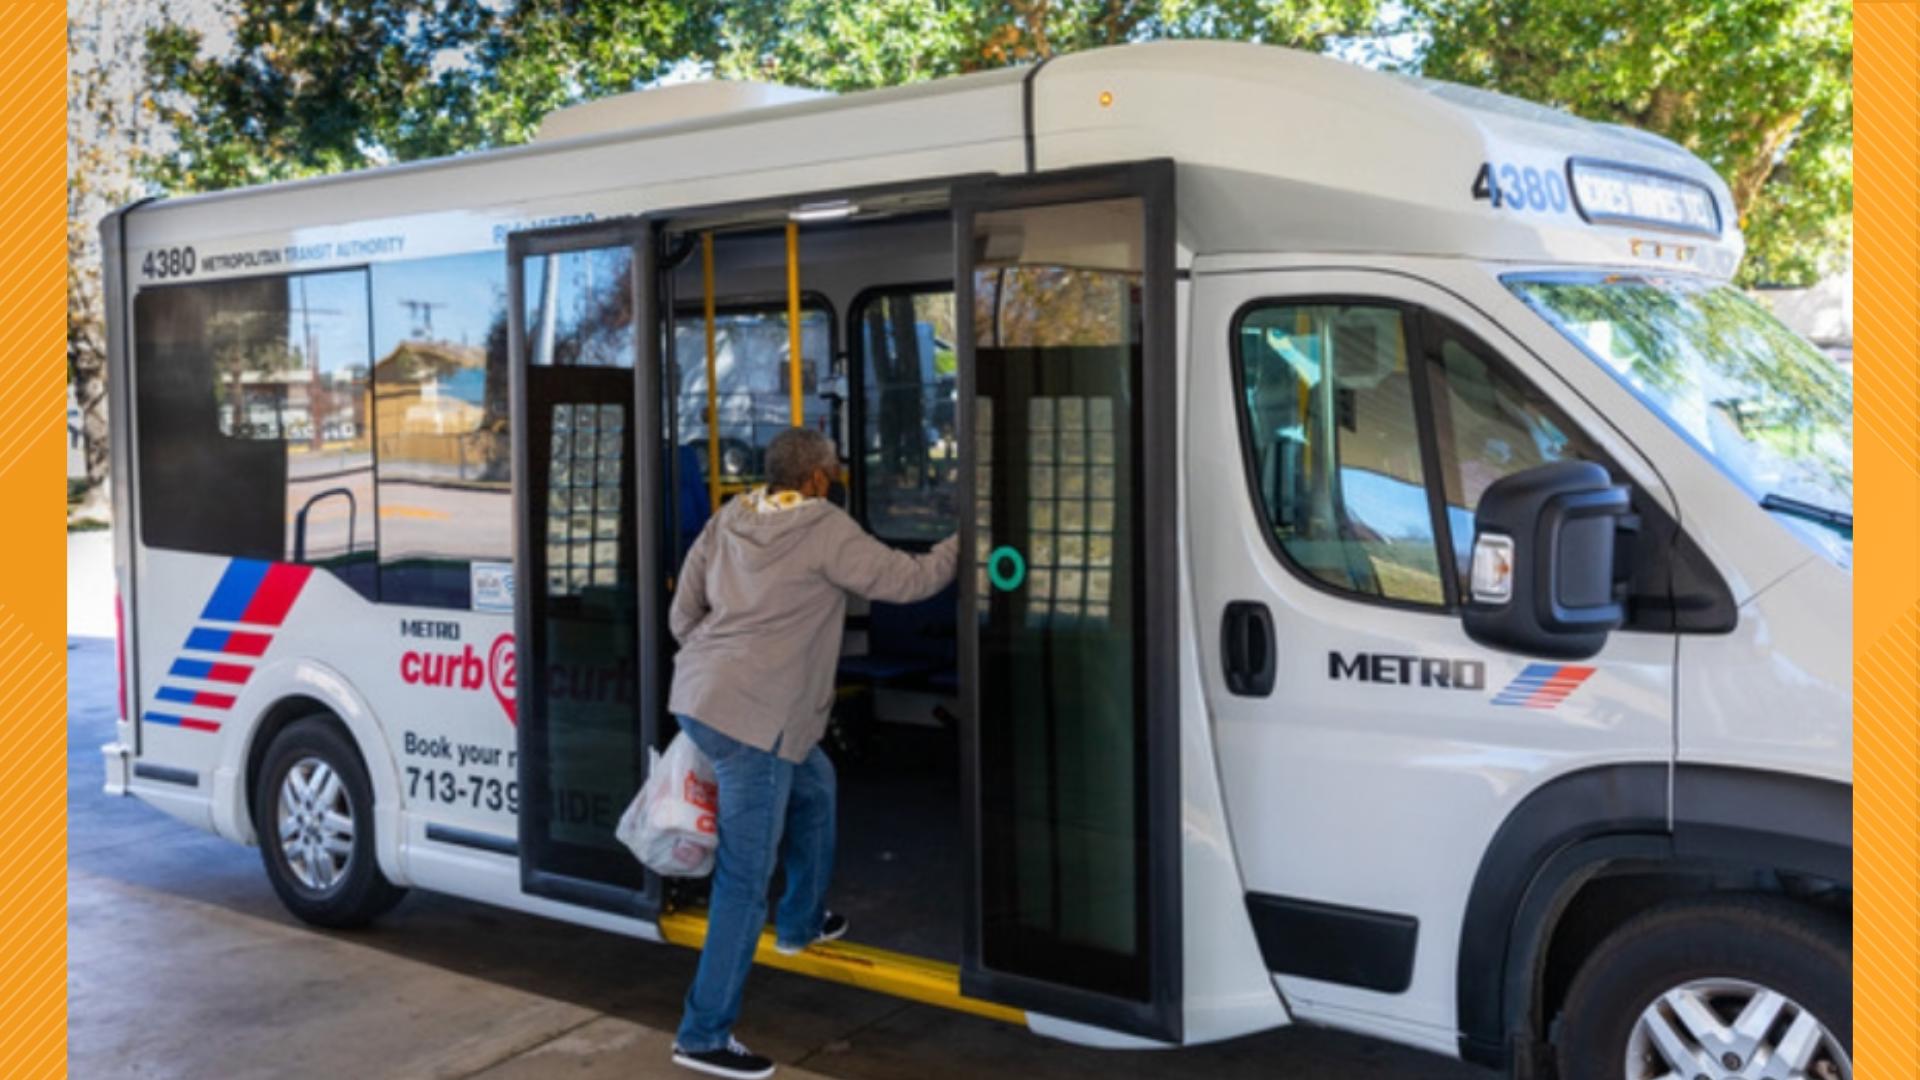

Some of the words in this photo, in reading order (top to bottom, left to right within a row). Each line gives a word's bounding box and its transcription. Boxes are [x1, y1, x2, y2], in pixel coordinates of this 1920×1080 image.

[1471, 161, 1567, 213] 4380
[141, 246, 197, 279] 4380
[201, 249, 282, 272] METROPOLITAN
[285, 243, 333, 262] TRANSIT
[336, 236, 406, 258] AUTHORITY
[401, 618, 461, 641] METRO
[401, 643, 485, 691] curb
[1328, 651, 1485, 691] METRO
[405, 731, 453, 759] Book
[457, 743, 502, 768] your
